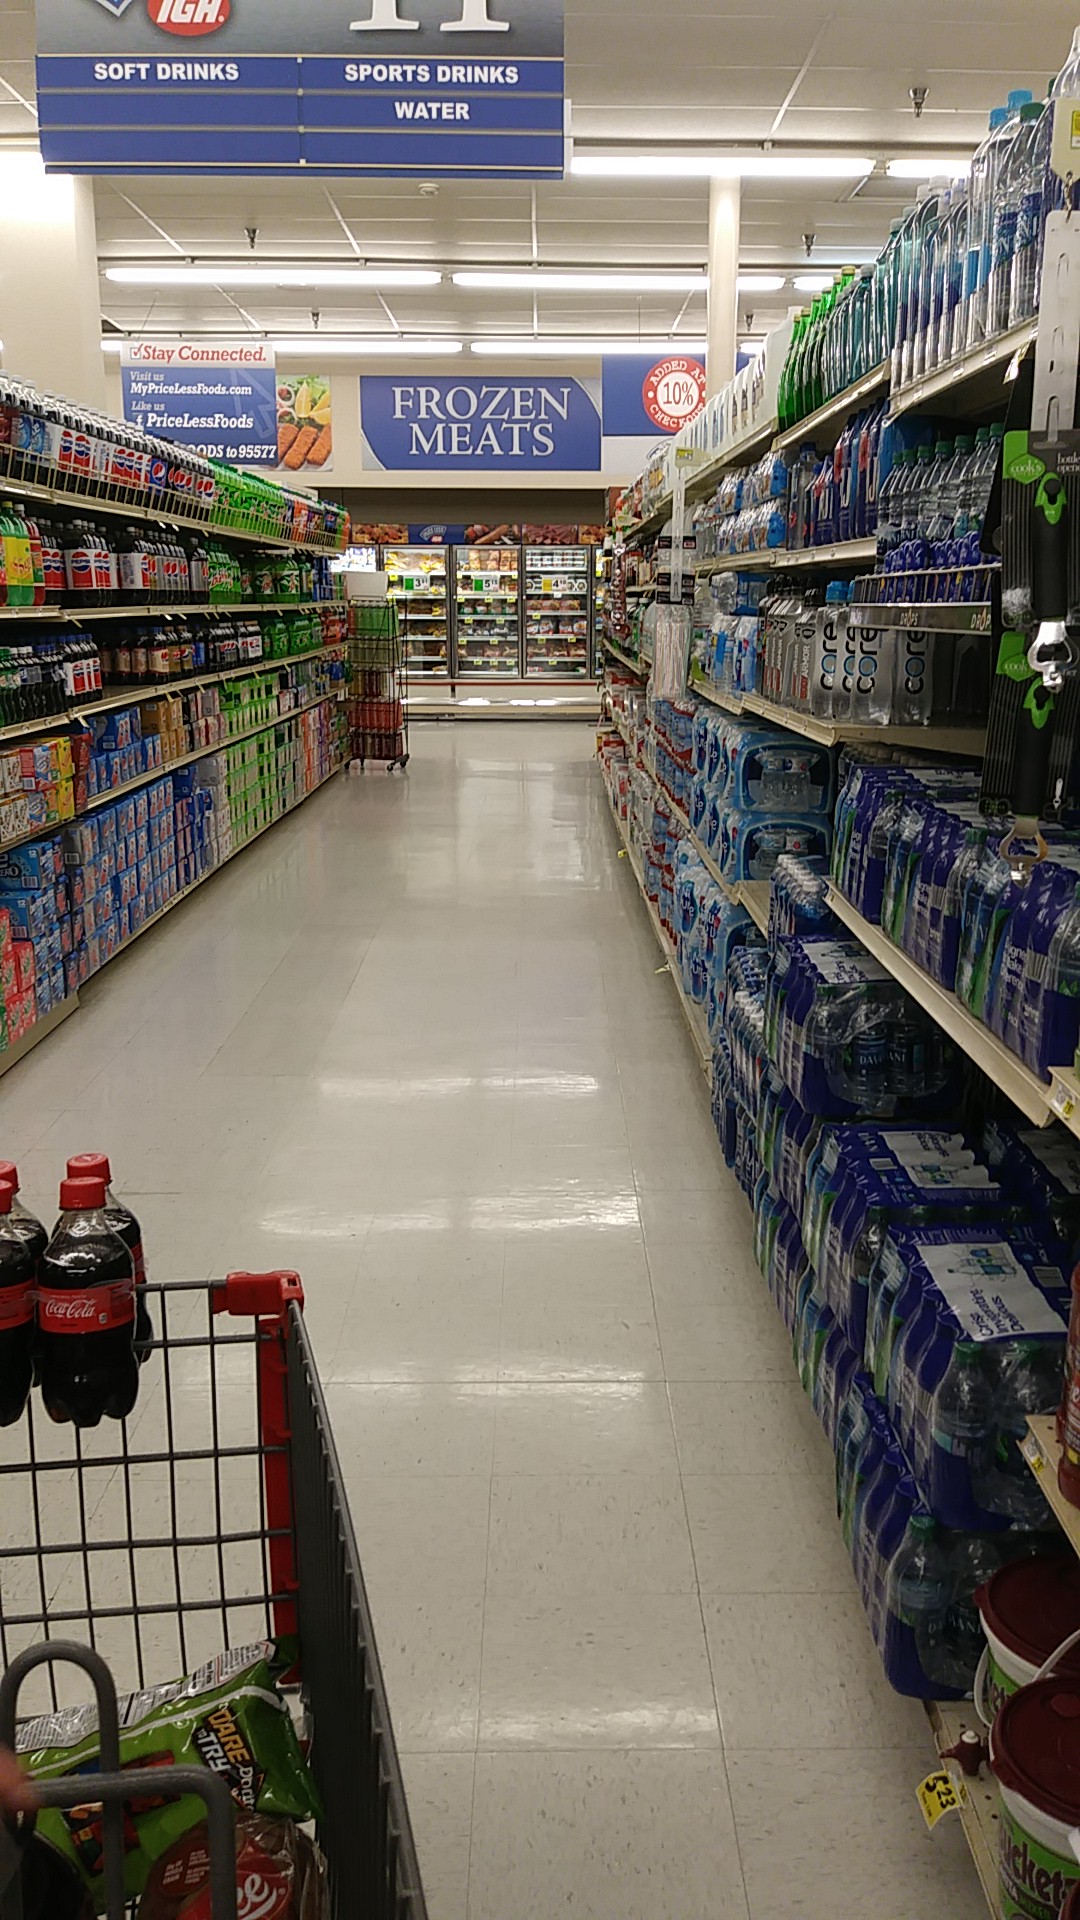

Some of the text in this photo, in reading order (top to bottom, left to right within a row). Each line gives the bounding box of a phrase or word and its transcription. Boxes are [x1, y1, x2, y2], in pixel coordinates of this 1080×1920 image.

[94, 63, 240, 81] SOFT DRINKS
[344, 64, 520, 84] SPORTS DRINKS
[394, 101, 470, 120] WATER
[142, 345, 267, 364] Stay Connected.
[130, 371, 165, 381] Visit us
[650, 360, 706, 387] ADDED AT
[130, 382, 253, 397] MyPriceLessFoods.com
[663, 381, 694, 405] 10%
[131, 401, 165, 411] Like us
[391, 386, 572, 421] FROZEN
[146, 412, 254, 429] PriceLessFoods
[408, 421, 556, 457] MEATS
[226, 445, 238, 458] to
[238, 445, 277, 459] 95577
[1010, 458, 1042, 473] cook's
[45, 1299, 97, 1319] Coca-Cola
[207, 1709, 252, 1766] DARE
[197, 1731, 233, 1772] TRY
